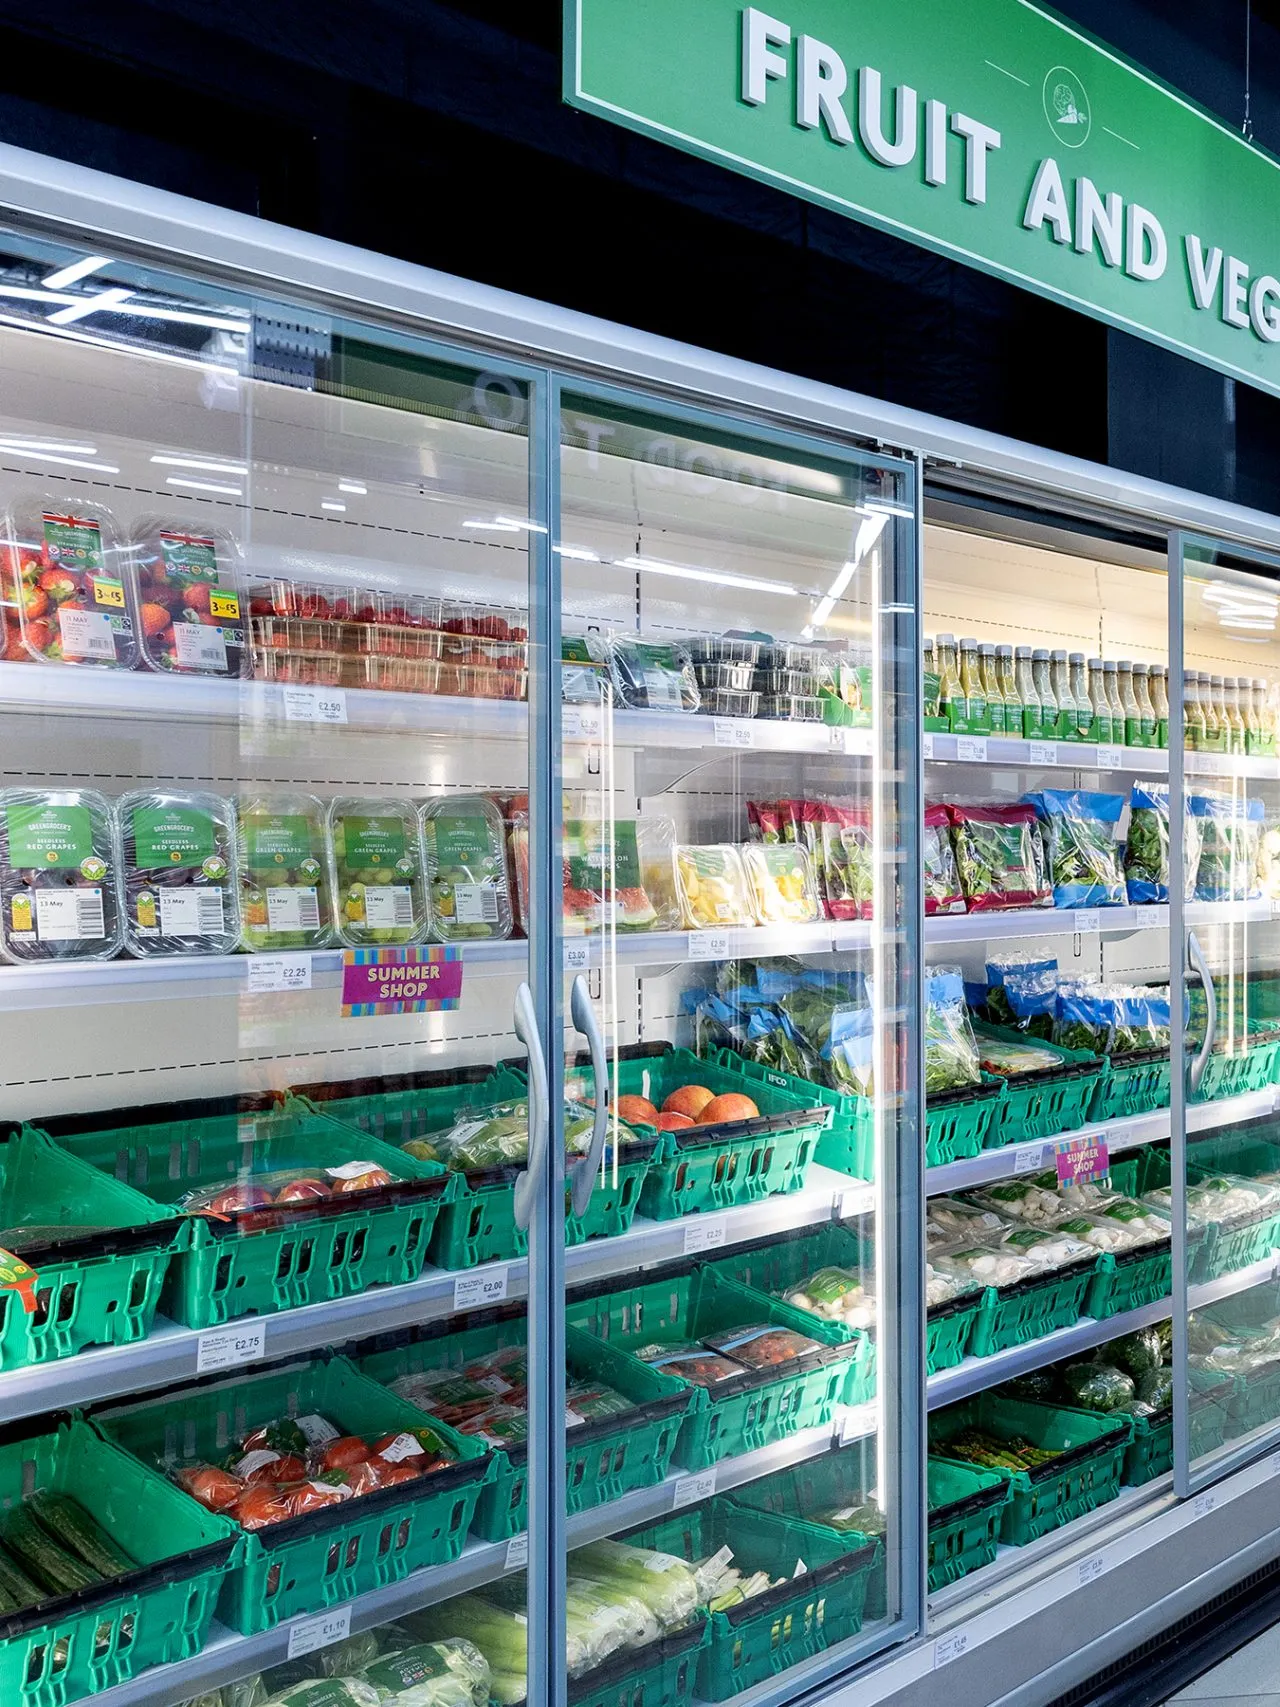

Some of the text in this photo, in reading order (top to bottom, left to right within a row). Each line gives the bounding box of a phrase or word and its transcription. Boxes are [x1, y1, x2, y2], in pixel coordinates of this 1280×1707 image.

[737, 6, 1000, 205] FRUIT
[1023, 158, 1167, 282] AND
[97, 589, 104, 599] 3
[212, 602, 219, 611] 3
[226, 603, 237, 614] £5
[319, 701, 341, 711] £2.50
[711, 940, 726, 948] £2.50
[568, 951, 585, 959] £3.00
[283, 967, 307, 977] £2.25
[368, 965, 440, 982] SUMMER
[380, 982, 428, 998] SHOP
[768, 1073, 787, 1086] IFCO
[1067, 1148, 1099, 1164] SUMMER
[1073, 1162, 1094, 1175] SHOP
[483, 1280, 503, 1292] £2.00
[235, 1336, 260, 1350] £2.75
[323, 1619, 346, 1634] £1.10
